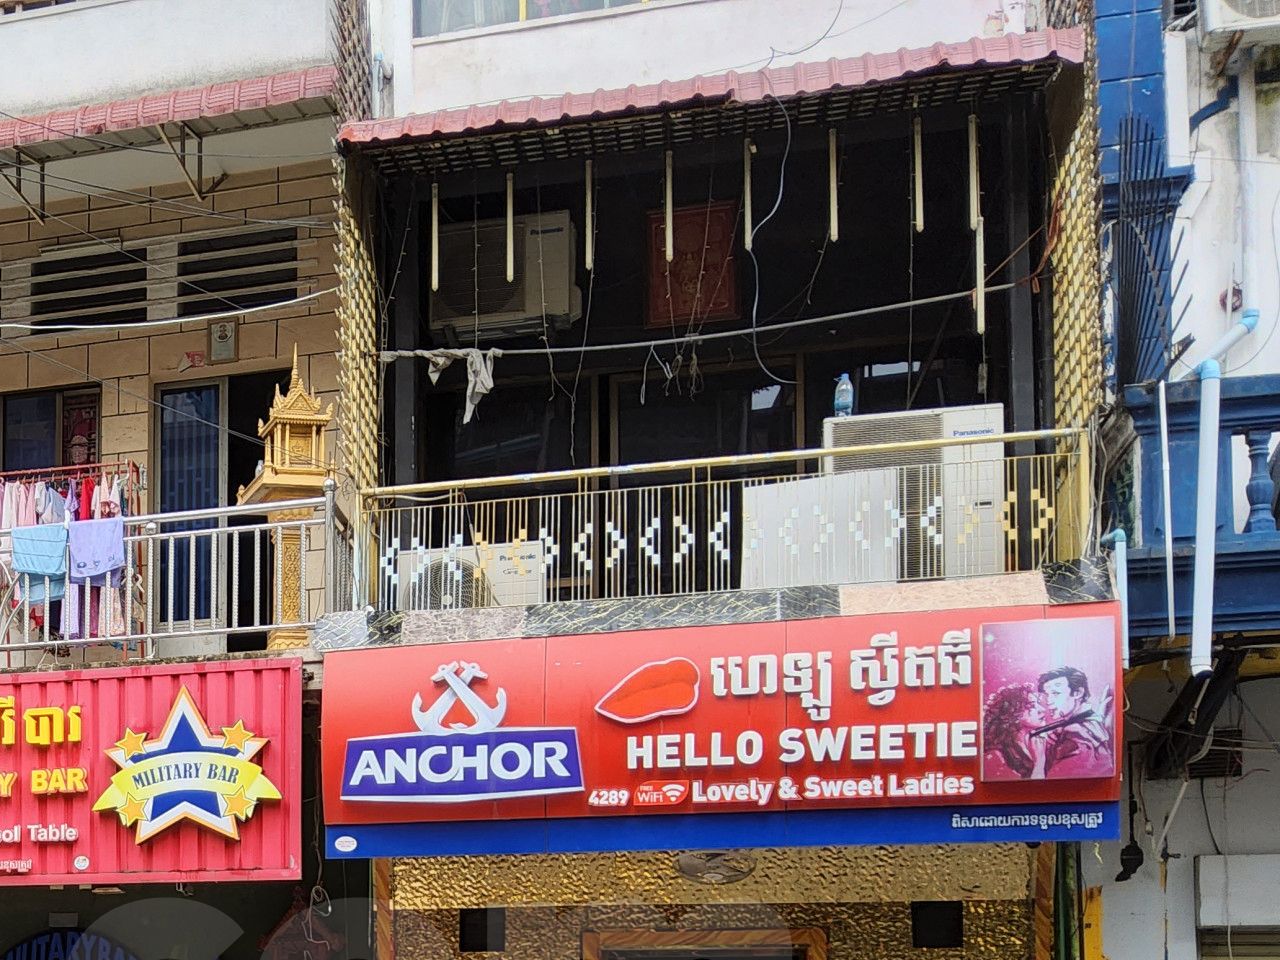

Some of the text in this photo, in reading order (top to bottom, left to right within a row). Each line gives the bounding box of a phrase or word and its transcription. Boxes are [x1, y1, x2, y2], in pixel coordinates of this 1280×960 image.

[952, 428, 995, 436] Panasonic
[626, 721, 978, 770] HELLO SWEETIE
[131, 760, 240, 788] MILITARY BAR
[350, 740, 570, 787] ANCHOR
[30, 767, 88, 795] BAR
[692, 769, 975, 807] Lovely & Sweet Ladies
[588, 789, 629, 806] 4289
[637, 791, 664, 803] WiFi
[26, 822, 79, 844] Table
